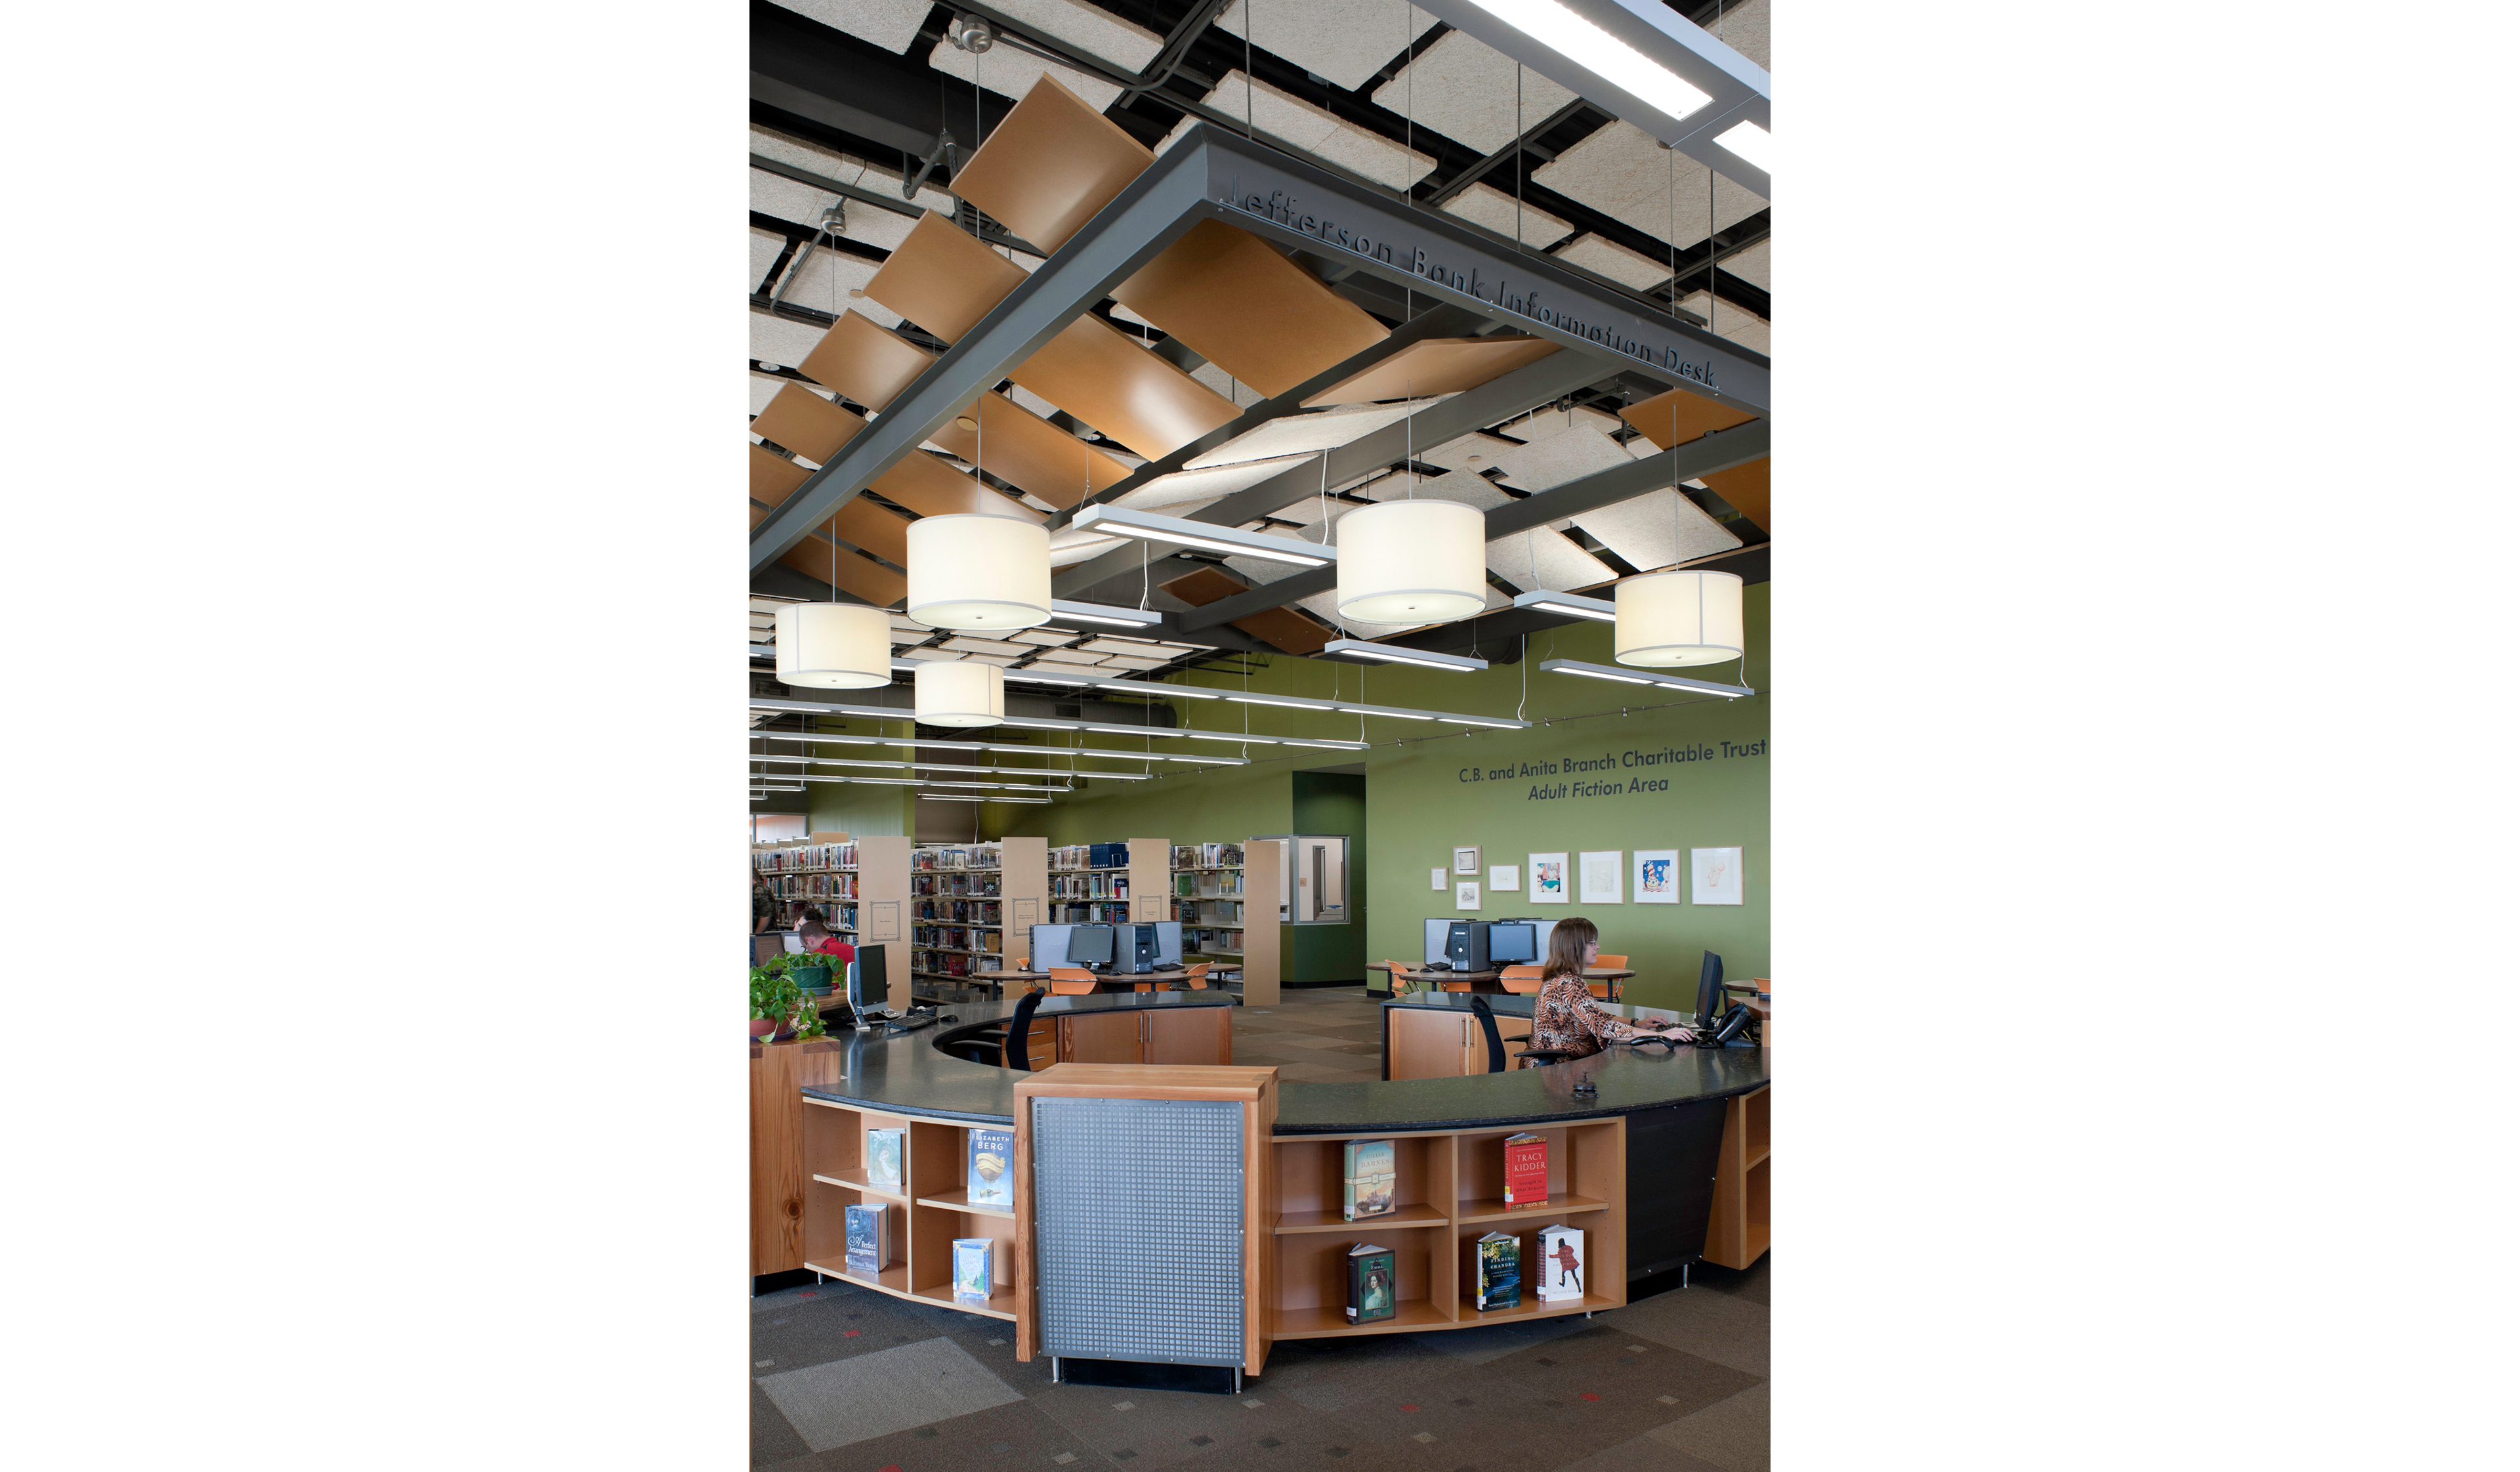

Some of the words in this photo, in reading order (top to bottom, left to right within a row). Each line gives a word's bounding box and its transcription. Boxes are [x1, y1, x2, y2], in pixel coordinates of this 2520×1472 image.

[1226, 174, 1394, 264] Jefferson
[1413, 245, 1485, 299] Bank
[1499, 280, 1652, 363] Information
[1664, 345, 1717, 387] Desk
[1459, 767, 1484, 783] C.B.
[1489, 763, 1515, 780] and
[1519, 760, 1557, 778] Anita
[1563, 753, 1616, 773] Branch
[1622, 743, 1714, 768] Charitable
[1720, 739, 1767, 759] Trust
[1528, 782, 1568, 801] Adult
[1572, 780, 1623, 798] Fiction
[1628, 777, 1669, 793] Area
[977, 1141, 1003, 1150] BERG
[1516, 1152, 1542, 1162] TRACY
[1361, 1158, 1390, 1168] BARNES
[1514, 1162, 1546, 1172] KIDDER
[861, 1240, 876, 1250] Perfect
[848, 1246, 877, 1256] Arrangement
